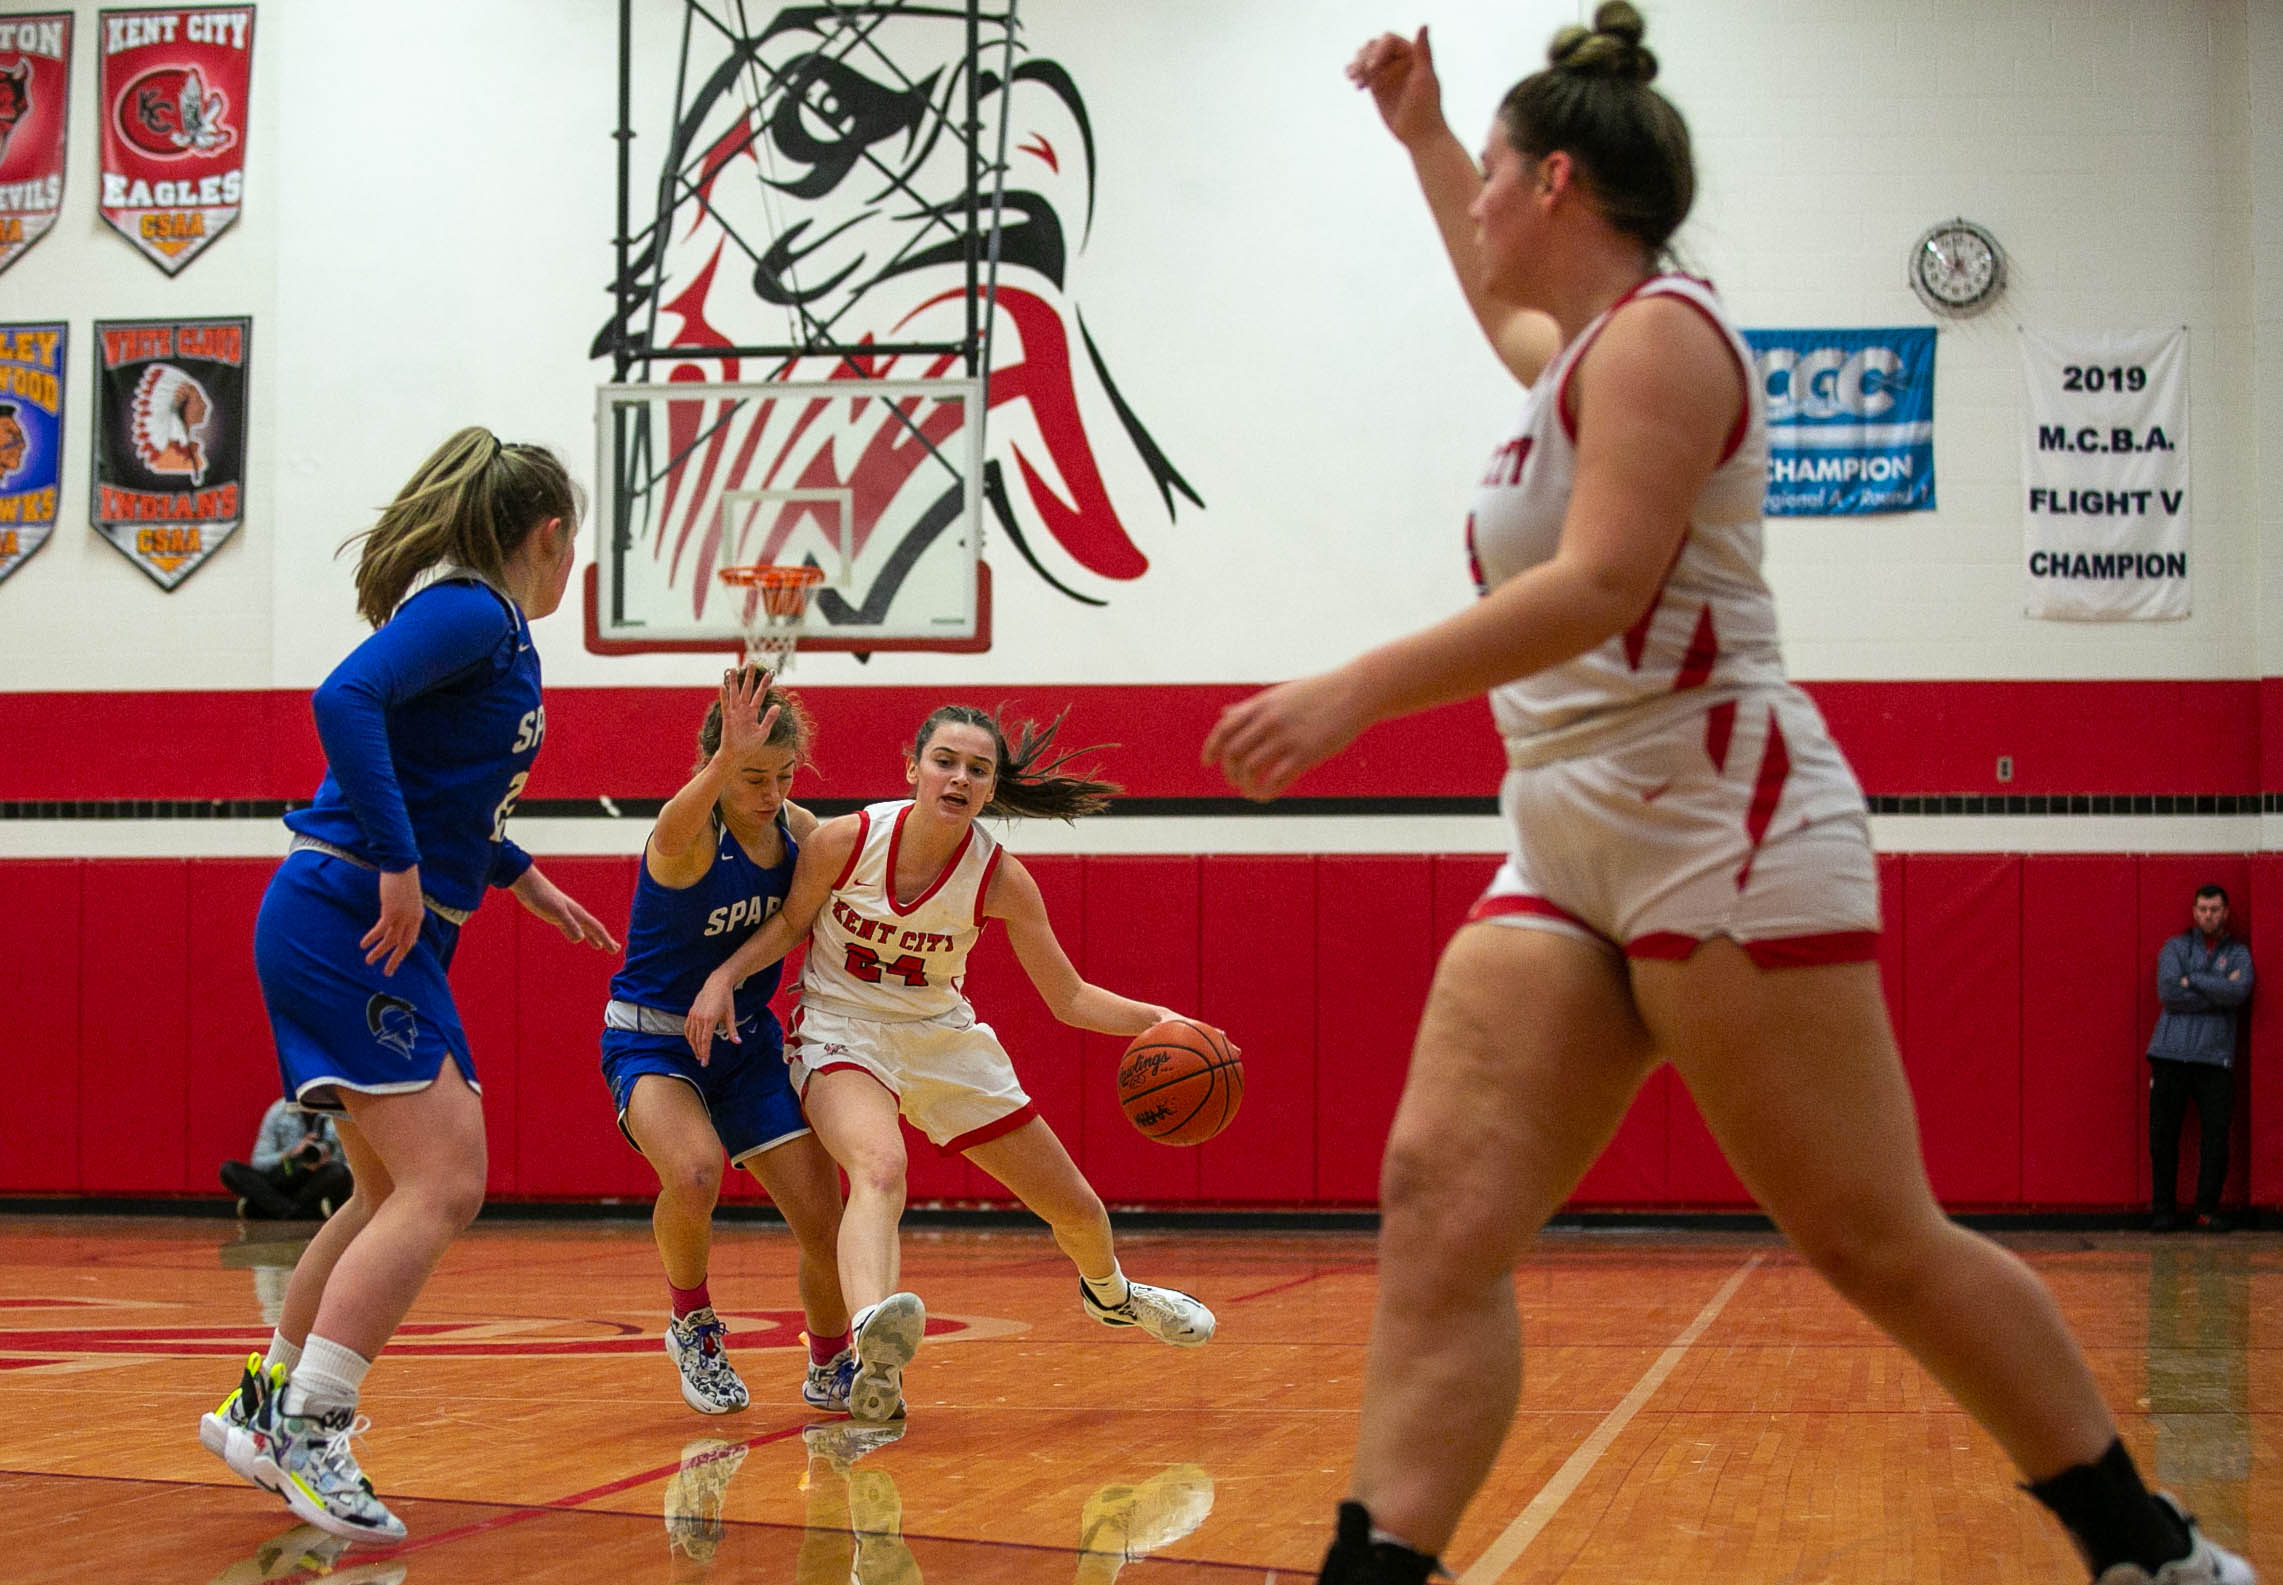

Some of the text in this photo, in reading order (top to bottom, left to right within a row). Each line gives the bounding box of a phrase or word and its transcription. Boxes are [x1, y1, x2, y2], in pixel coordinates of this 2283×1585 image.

[106, 13, 247, 55] KENT CITY
[103, 171, 242, 207] EAGLES
[140, 213, 204, 238] CSAA
[2062, 366, 2147, 392] 2019
[2038, 426, 2175, 453] M.C.B.A.
[100, 484, 237, 521] INDIANS
[2029, 489, 2183, 515] FLIGHT V
[136, 528, 201, 554] CSAA
[2029, 552, 2187, 579] CHAMPION
[832, 899, 898, 944] KENT
[844, 942, 929, 987] 24
